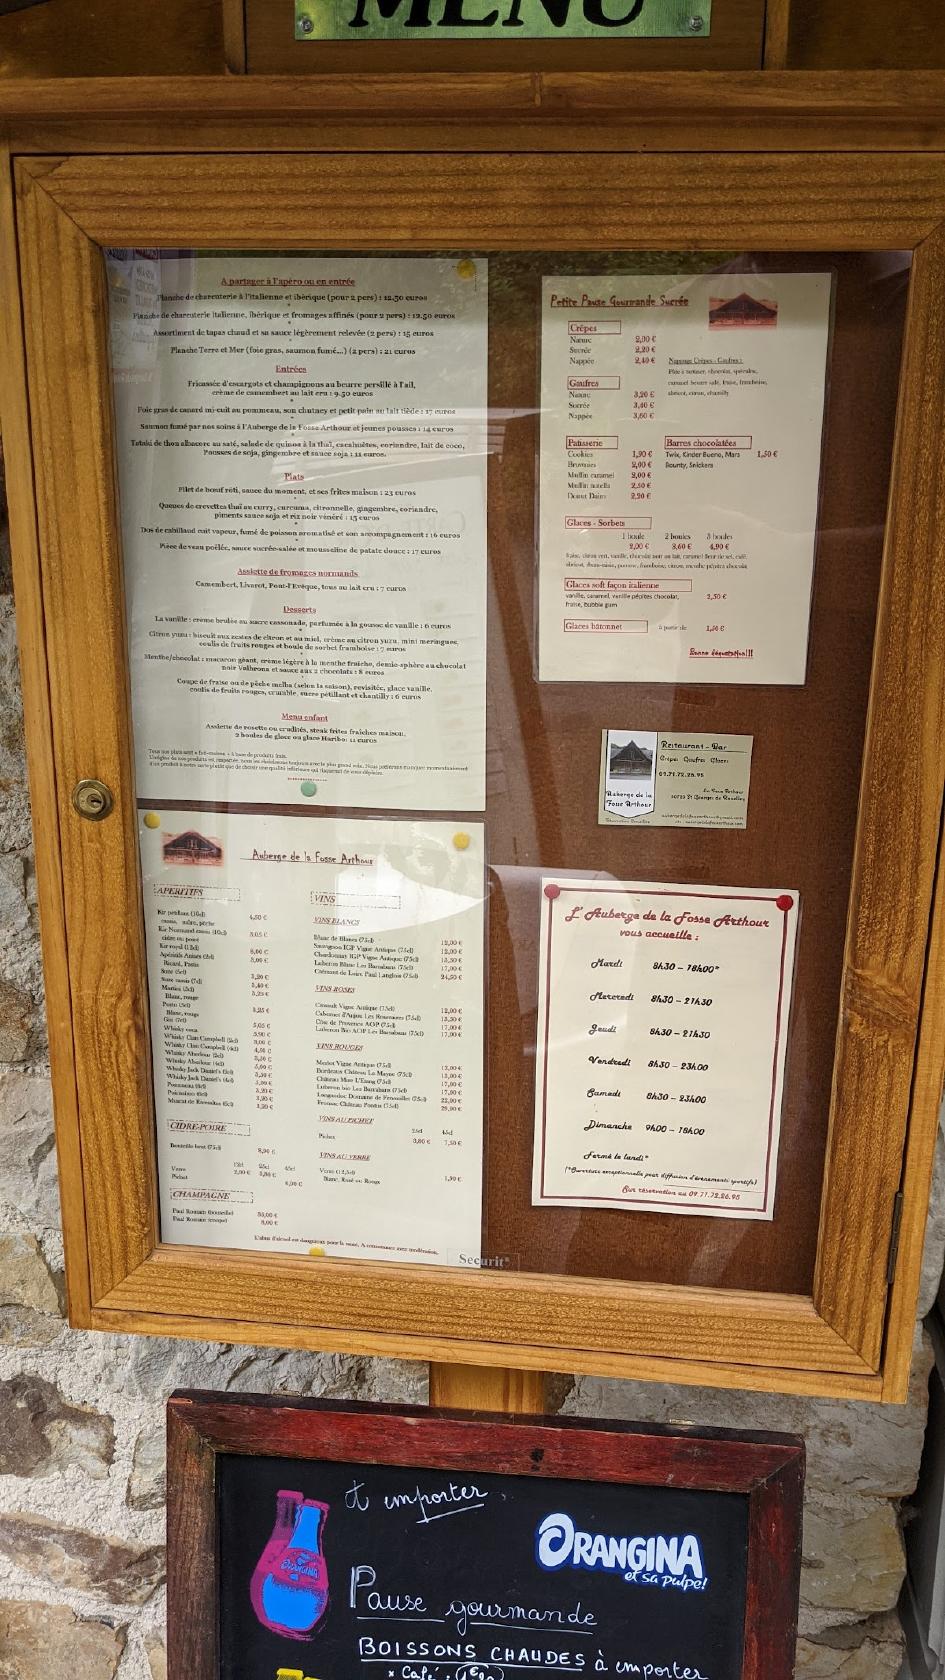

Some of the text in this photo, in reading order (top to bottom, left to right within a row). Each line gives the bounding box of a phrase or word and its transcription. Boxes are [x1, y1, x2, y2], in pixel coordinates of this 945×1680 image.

[228, 278, 264, 287] partager
[331, 277, 356, 286] entrée
[551, 294, 577, 307] Petite
[581, 293, 605, 307] Pause
[610, 294, 655, 308] Gourmande
[291, 311, 327, 321] fromages
[570, 324, 597, 334] Crêpes
[569, 379, 599, 388] Gaufres
[666, 439, 691, 448] Barres
[682, 451, 702, 459] Kinder
[566, 519, 625, 528] Glaces Sorbets
[269, 569, 279, 577] de
[280, 569, 316, 579] fromages
[318, 570, 359, 578] normands
[566, 581, 590, 589] Glaces
[283, 605, 317, 614] Desserts
[281, 713, 328, 723] Menu enfant
[661, 740, 704, 750] Restaurant
[252, 849, 374, 866] Auberge de la Fosse Arthour
[314, 894, 336, 904] VINS
[643, 909, 656, 921] de
[660, 910, 672, 922] la
[674, 911, 711, 926] Fosse
[713, 914, 770, 928] Arthour
[620, 929, 692, 941] vous accueille
[591, 958, 623, 969] Mardi
[653, 962, 675, 971] 8h30
[590, 991, 713, 1007] Mercredi 8h30 21h30
[588, 1023, 710, 1039] Jeudi 8h30 21h30
[588, 1055, 708, 1072] Vendredi 8h30 23h00
[586, 1087, 707, 1104] Samedi 8h30 23h00
[583, 1119, 705, 1136] Dimanche 9h00 18h00
[583, 1150, 612, 1160] Fermé
[614, 1152, 621, 1160] le
[172, 1190, 231, 1201] CHAMPAGNE
[538, 1513, 704, 1580] ORANGINA
[624, 1570, 708, 1592] et sa pulpe!
[350, 1565, 598, 1636] Pause gourmande
[359, 1637, 478, 1660] BOISSONS
[491, 1647, 585, 1668] CHAUDES
[595, 1649, 609, 1673] à
